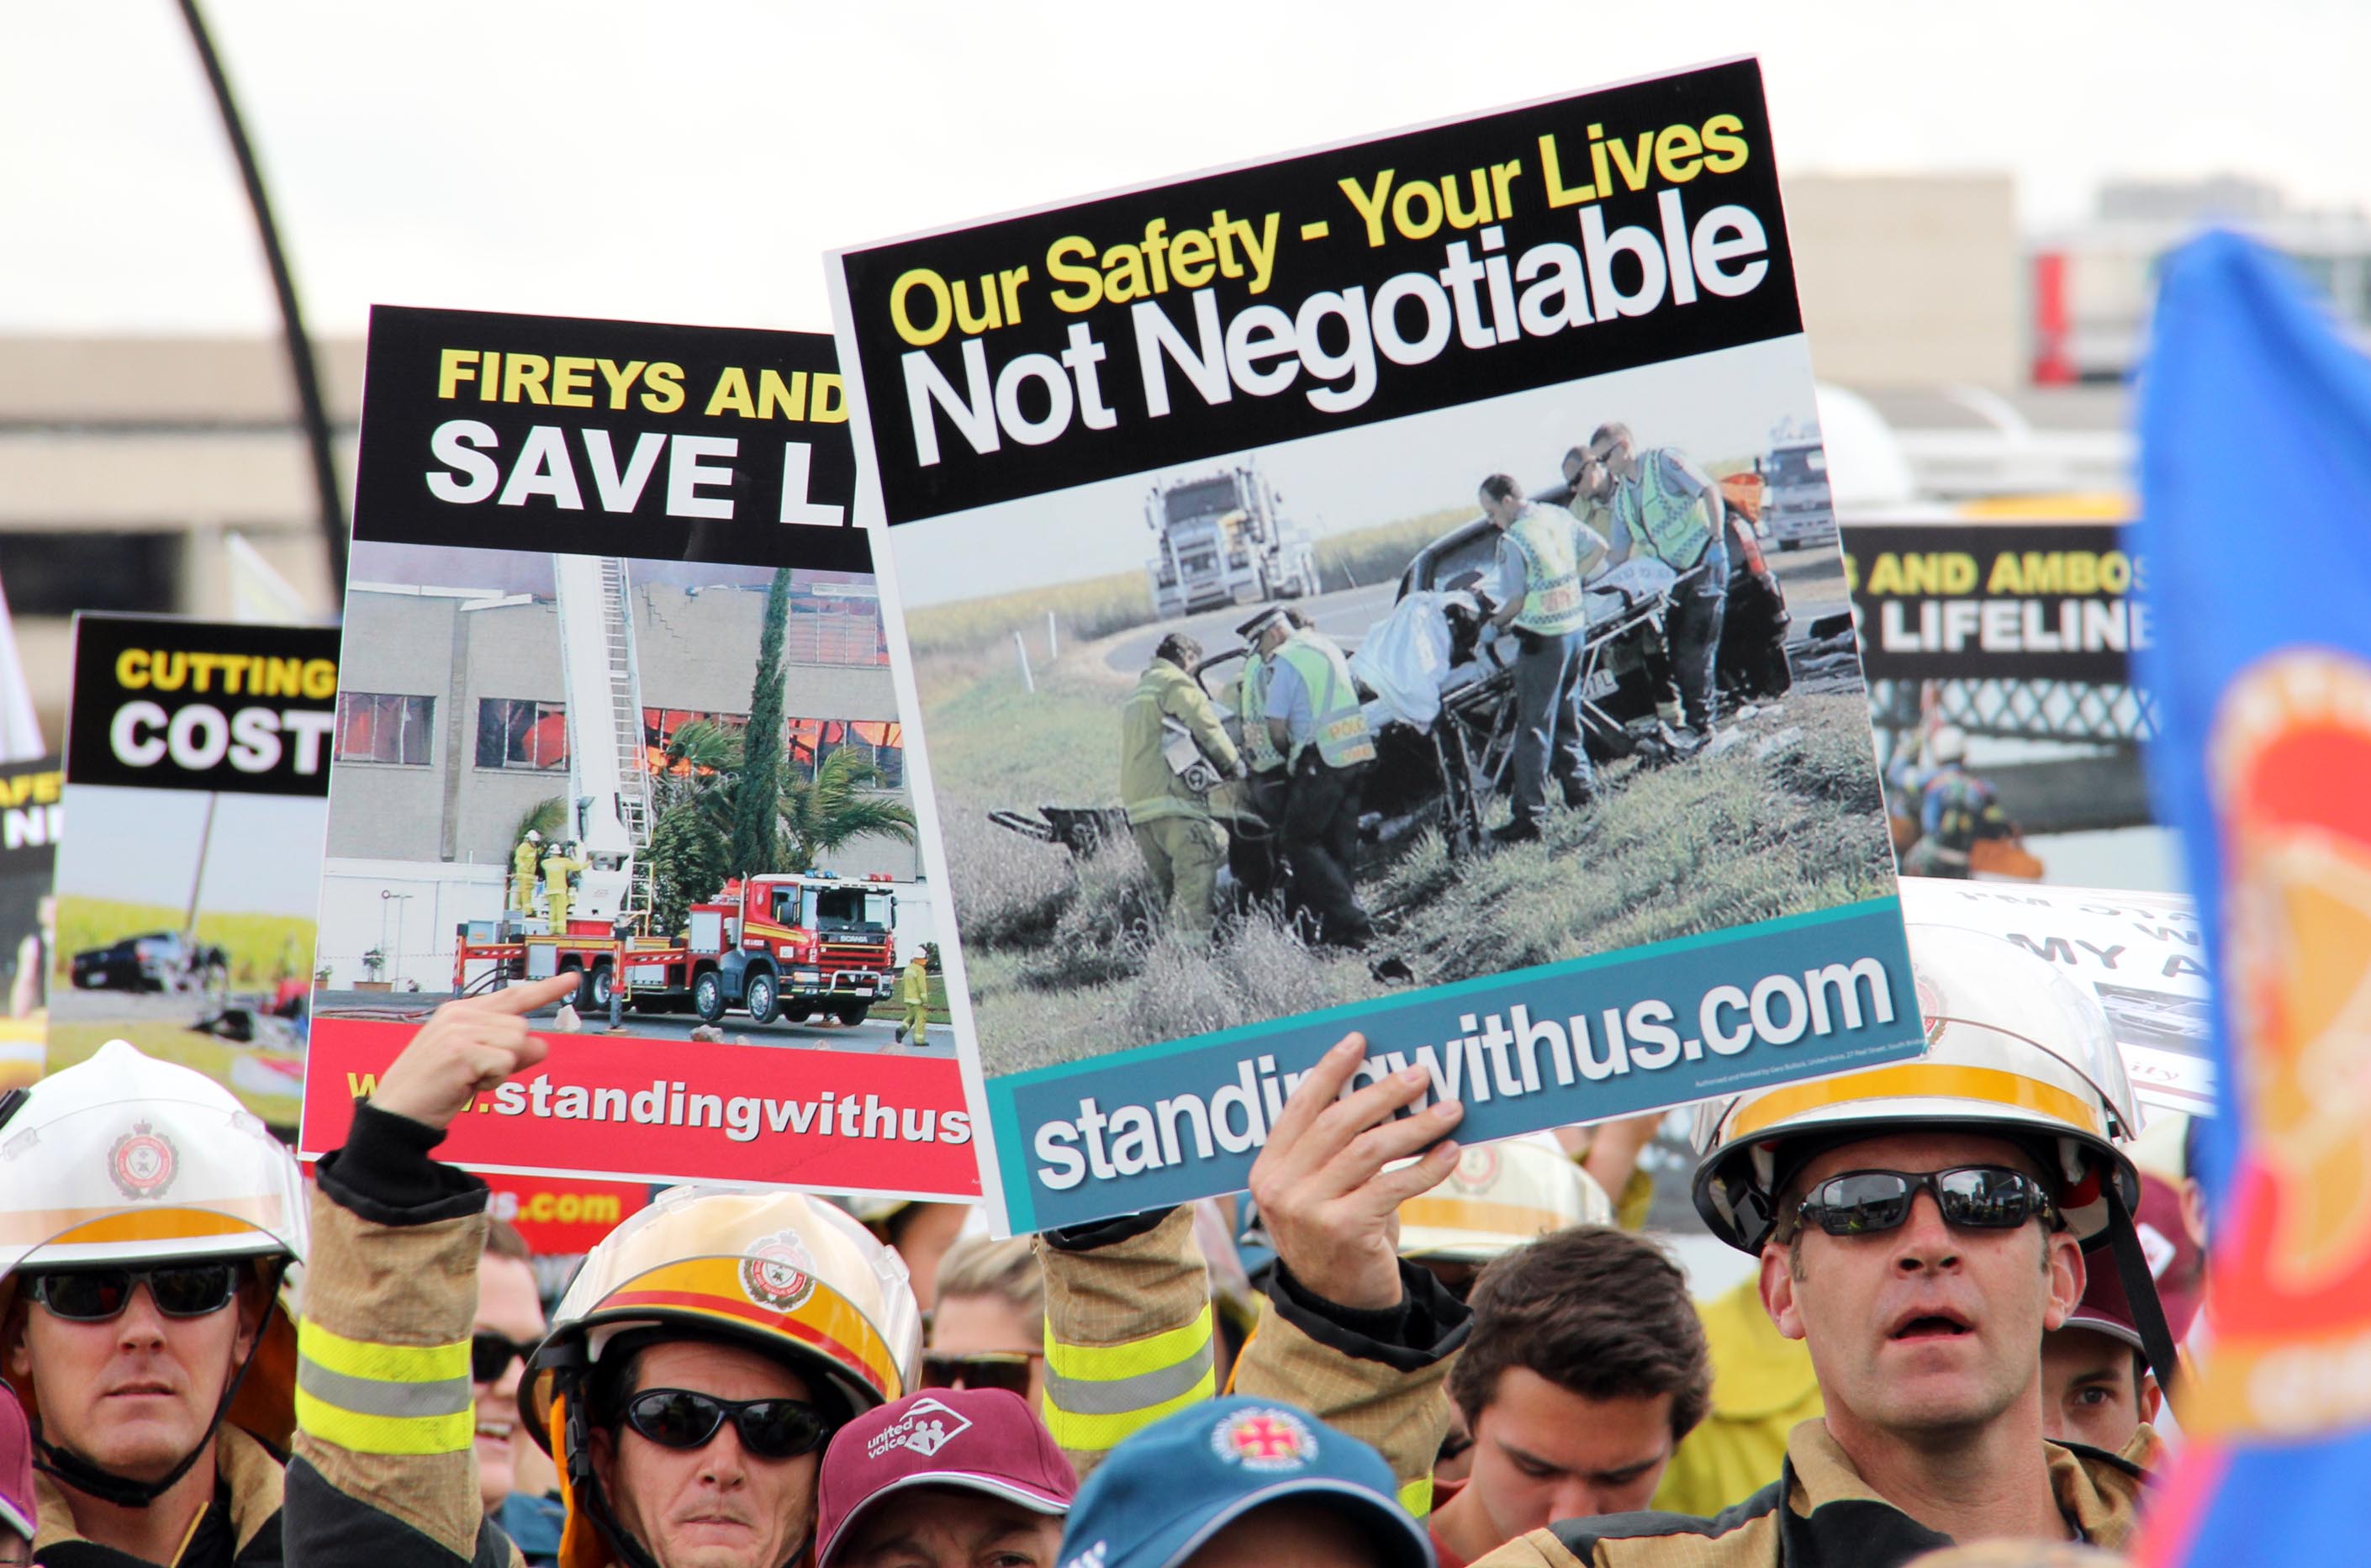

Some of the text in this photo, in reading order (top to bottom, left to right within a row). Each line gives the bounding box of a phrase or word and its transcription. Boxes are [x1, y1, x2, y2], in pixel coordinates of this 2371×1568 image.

[890, 266, 1029, 346] Our
[1046, 209, 1281, 313] Safety
[1337, 159, 1522, 247] Your
[1538, 113, 1750, 209] Lives
[901, 187, 1769, 467] Not Negotiable
[438, 349, 849, 423] FIREYS AND
[426, 420, 739, 520] SAVE
[1867, 552, 1978, 595] AND
[115, 647, 336, 700] CUTTING
[109, 700, 336, 775] COST
[1033, 956, 1895, 1191] standiwithus.com
[867, 1416, 913, 1449] united
[868, 1434, 906, 1460] voice
